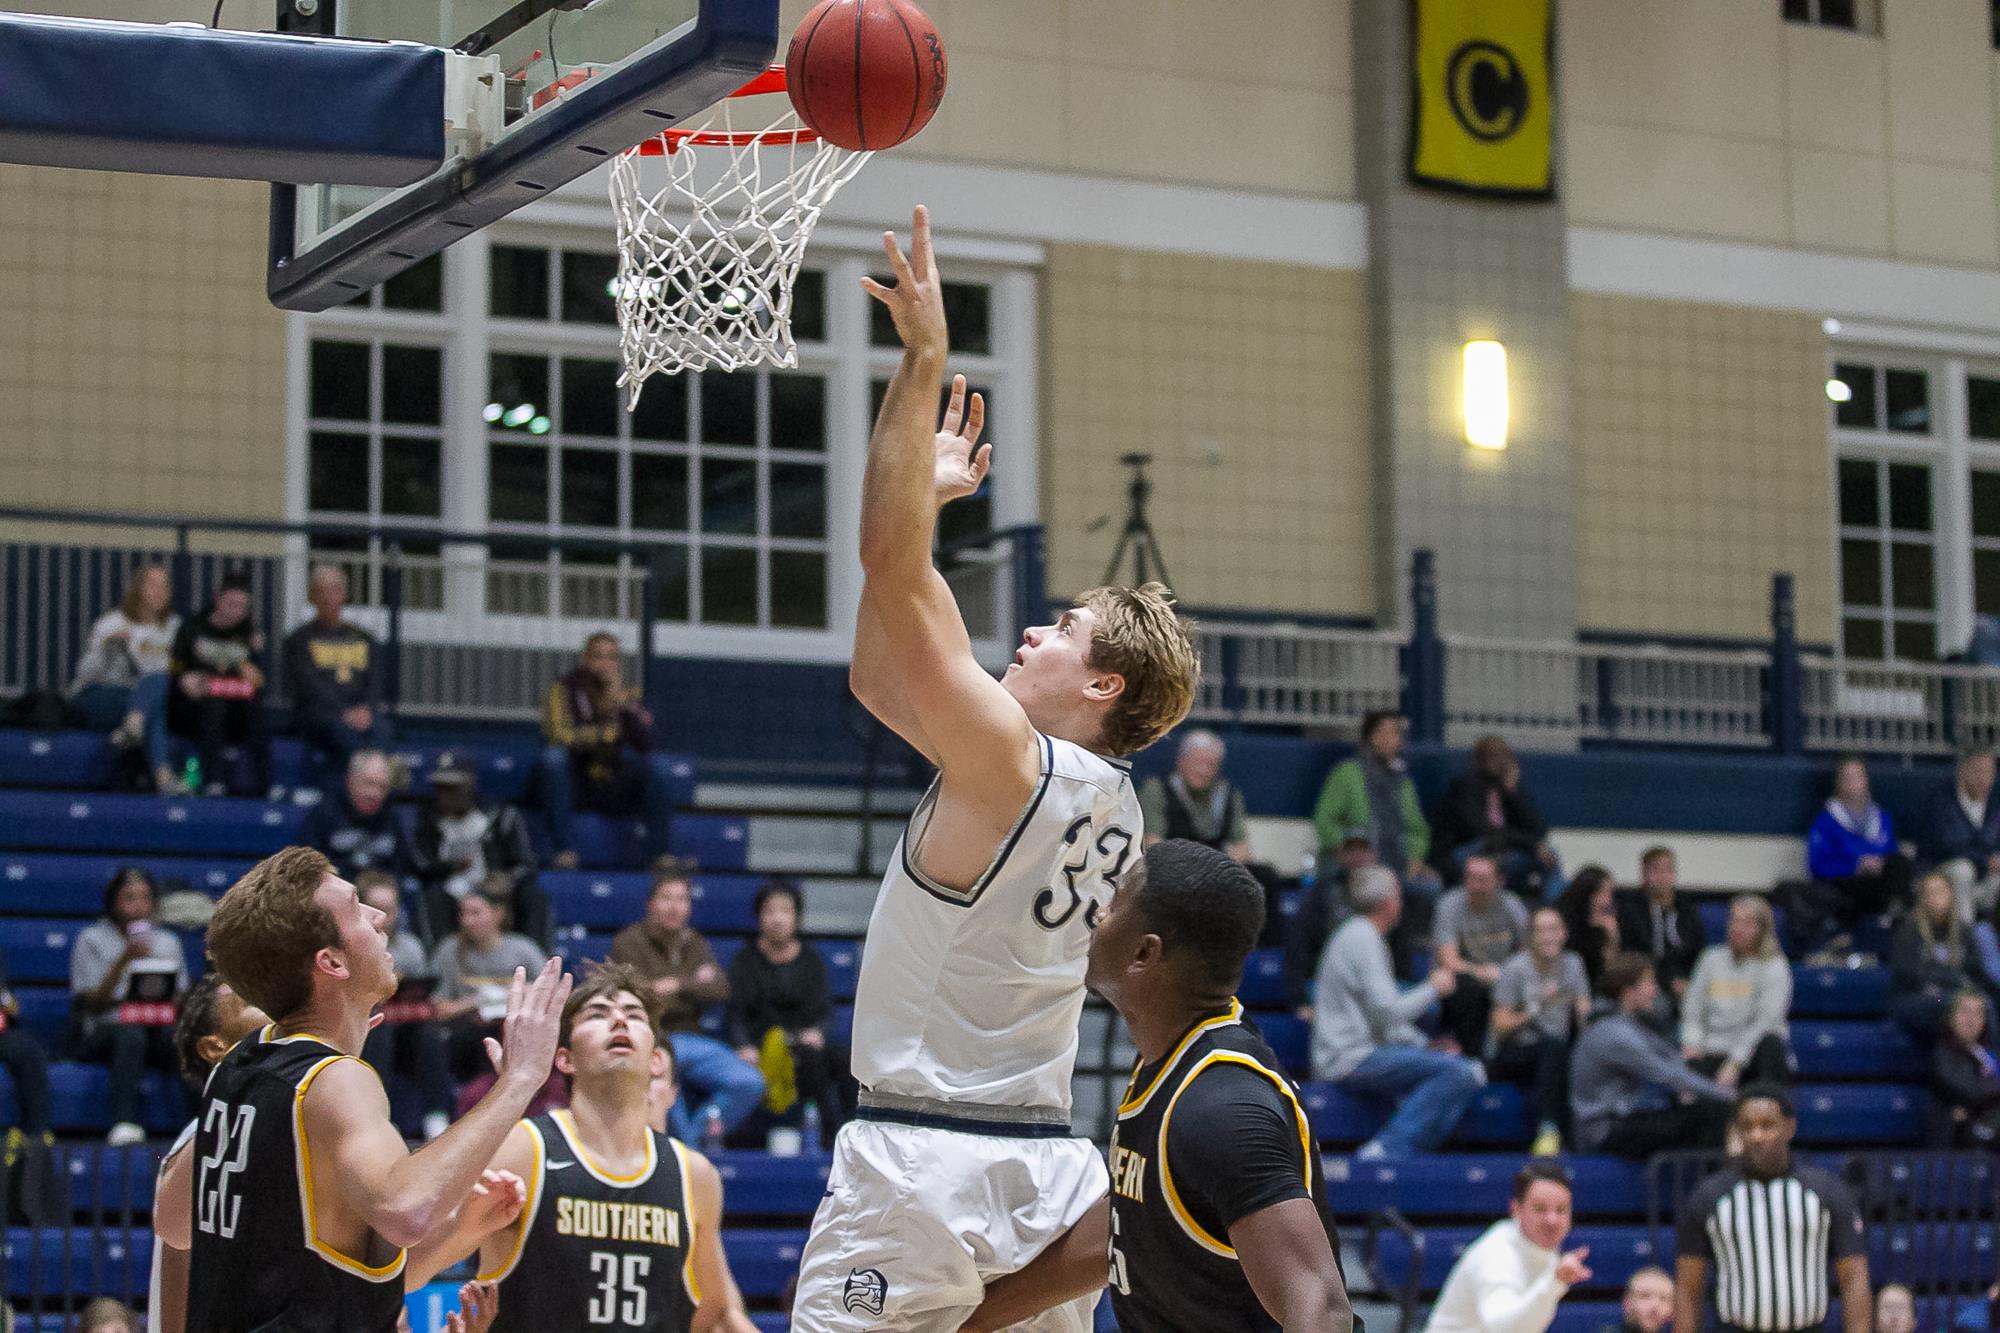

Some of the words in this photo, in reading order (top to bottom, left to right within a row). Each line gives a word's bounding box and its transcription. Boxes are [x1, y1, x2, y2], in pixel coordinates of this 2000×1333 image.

[1449, 43, 1524, 141] C
[1031, 813, 1132, 932] 33
[199, 1098, 256, 1239] 22
[556, 1197, 680, 1248] SOUTHERN
[589, 1251, 651, 1327] 35
